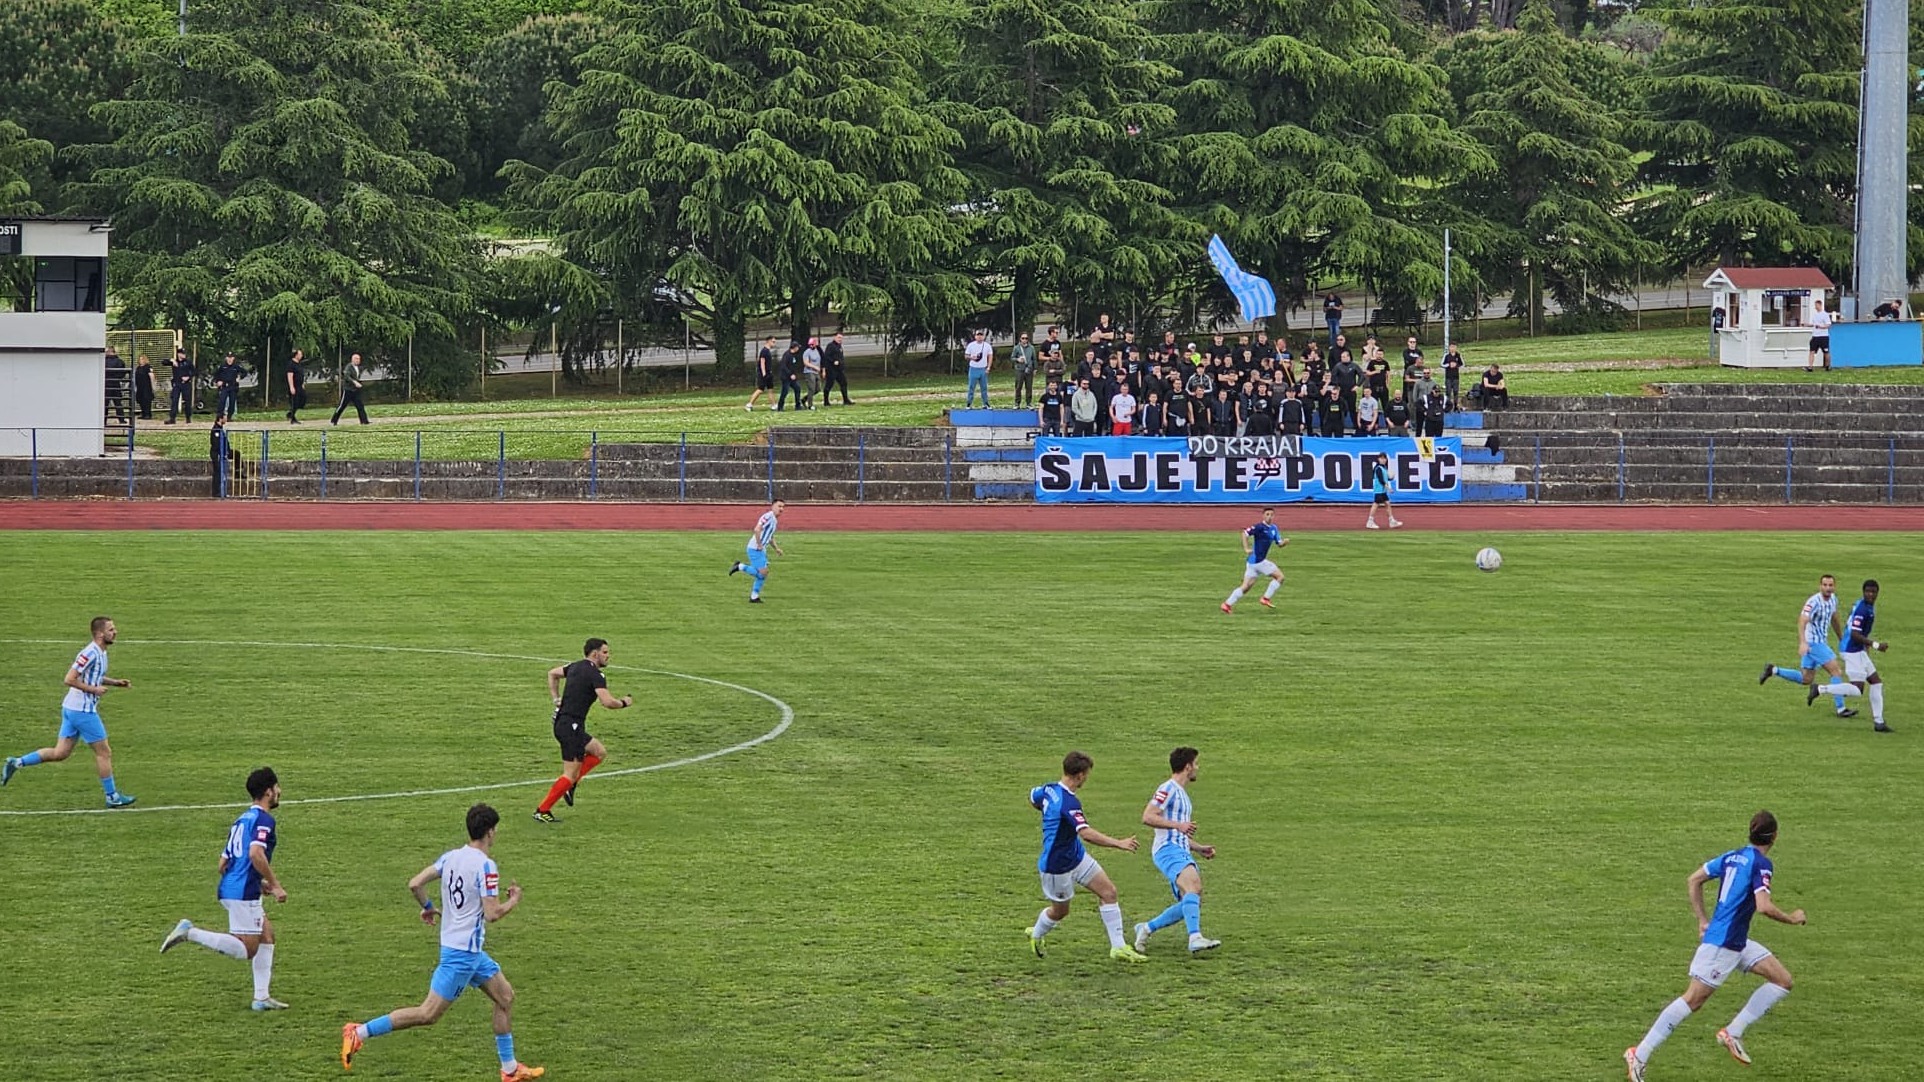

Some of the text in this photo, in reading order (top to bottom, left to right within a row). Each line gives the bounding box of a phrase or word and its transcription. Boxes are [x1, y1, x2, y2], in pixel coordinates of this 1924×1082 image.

[1188, 434, 1301, 458] DO KRAJA!
[1039, 446, 1249, 492] ŠAJETE
[448, 869, 465, 910] 18
[1719, 866, 1738, 903] 11
